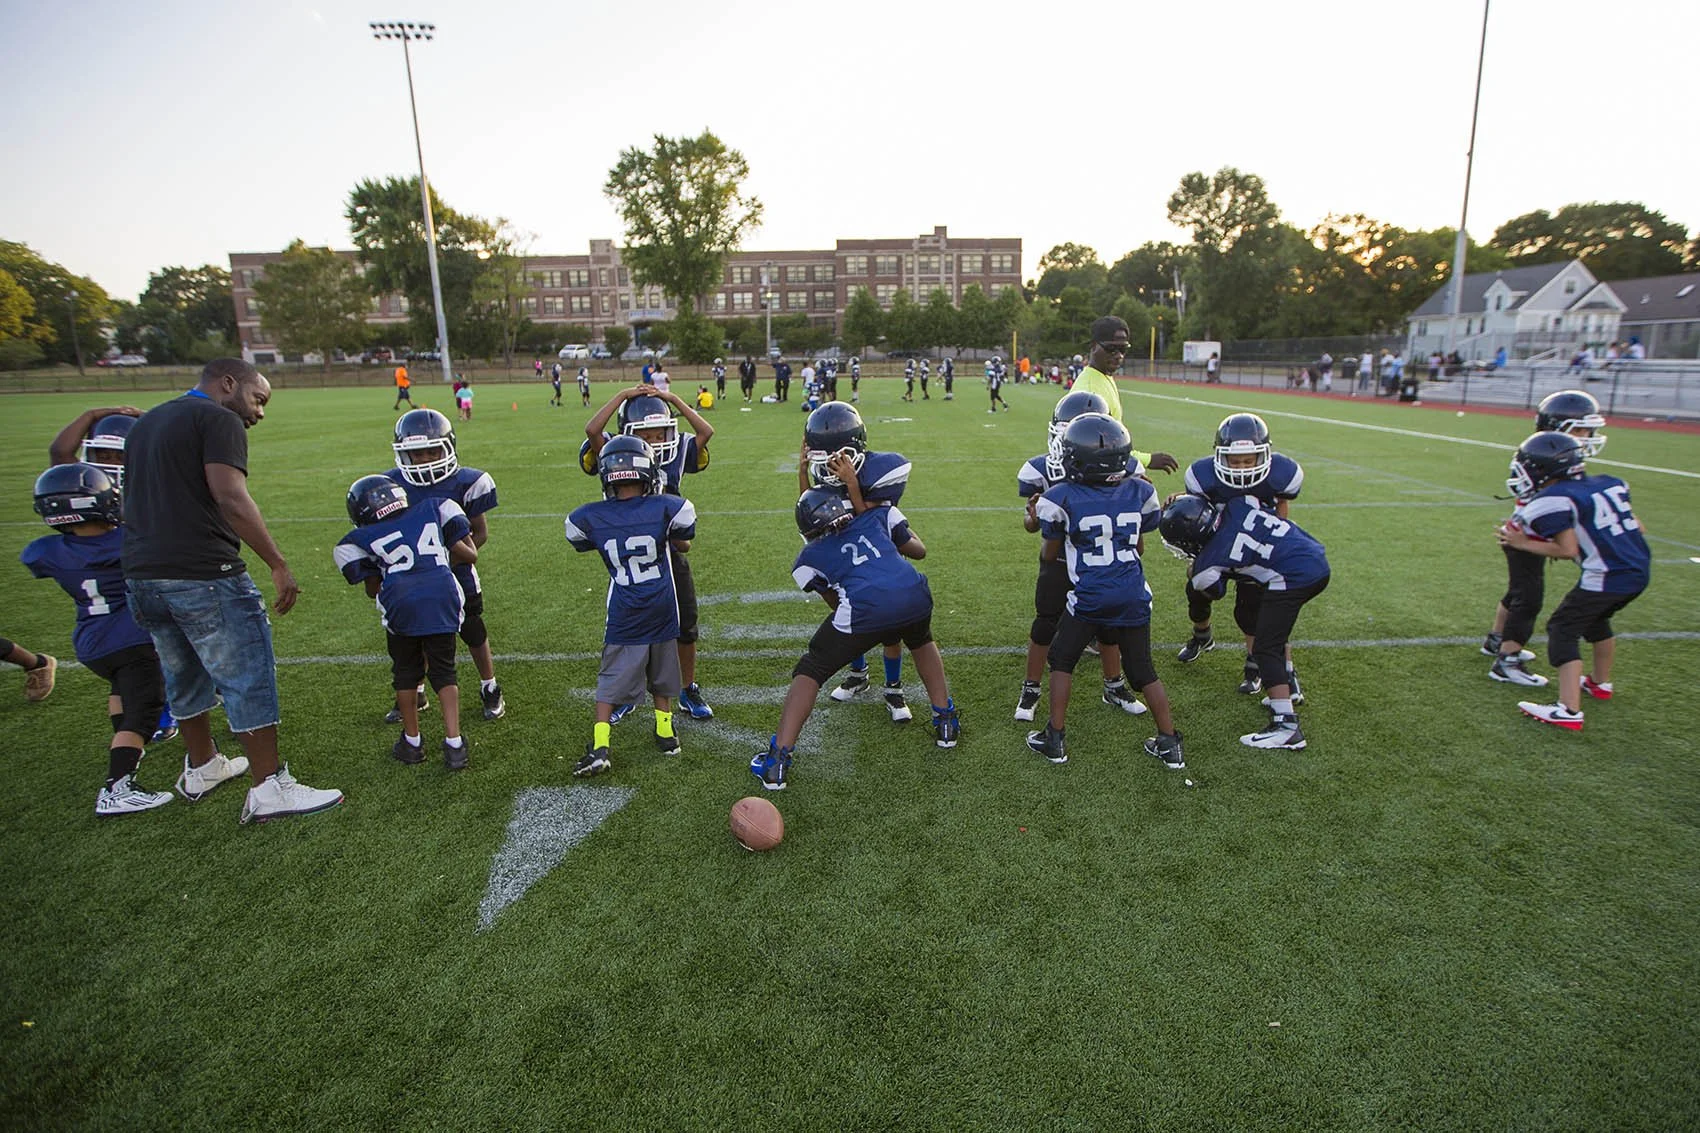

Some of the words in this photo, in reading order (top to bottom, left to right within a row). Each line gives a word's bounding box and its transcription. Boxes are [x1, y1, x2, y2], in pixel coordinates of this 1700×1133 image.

[609, 471, 638, 480] Riddell
[1229, 509, 1291, 562] 73
[1591, 486, 1640, 536] 45
[370, 522, 450, 574] 54
[604, 535, 661, 586] 12
[841, 535, 881, 566] 21
[1079, 512, 1142, 566] 33
[81, 579, 110, 615] 1
